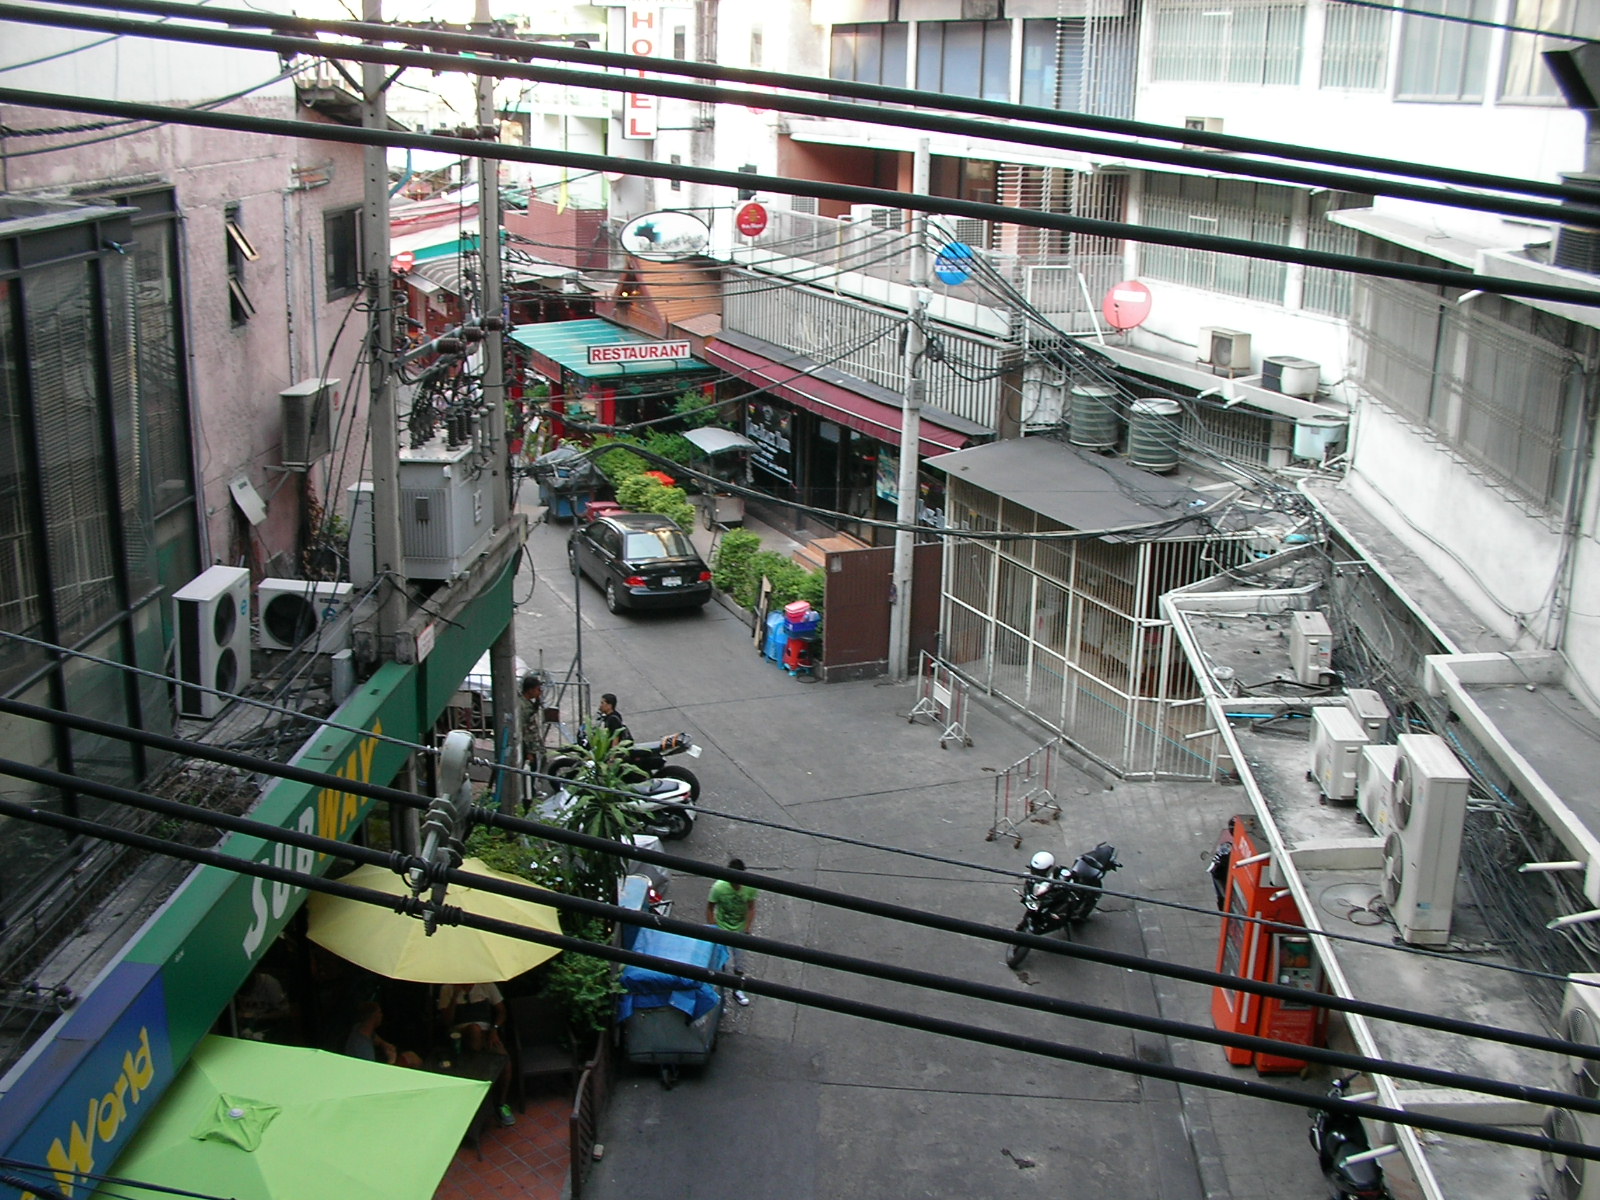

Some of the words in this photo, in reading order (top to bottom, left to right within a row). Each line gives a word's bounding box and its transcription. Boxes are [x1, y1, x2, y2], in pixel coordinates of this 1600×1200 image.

[631, 11, 653, 136] HOEL
[592, 344, 688, 361] RESTAURANT
[243, 716, 383, 961] SUBWAY
[46, 1025, 155, 1199] World
